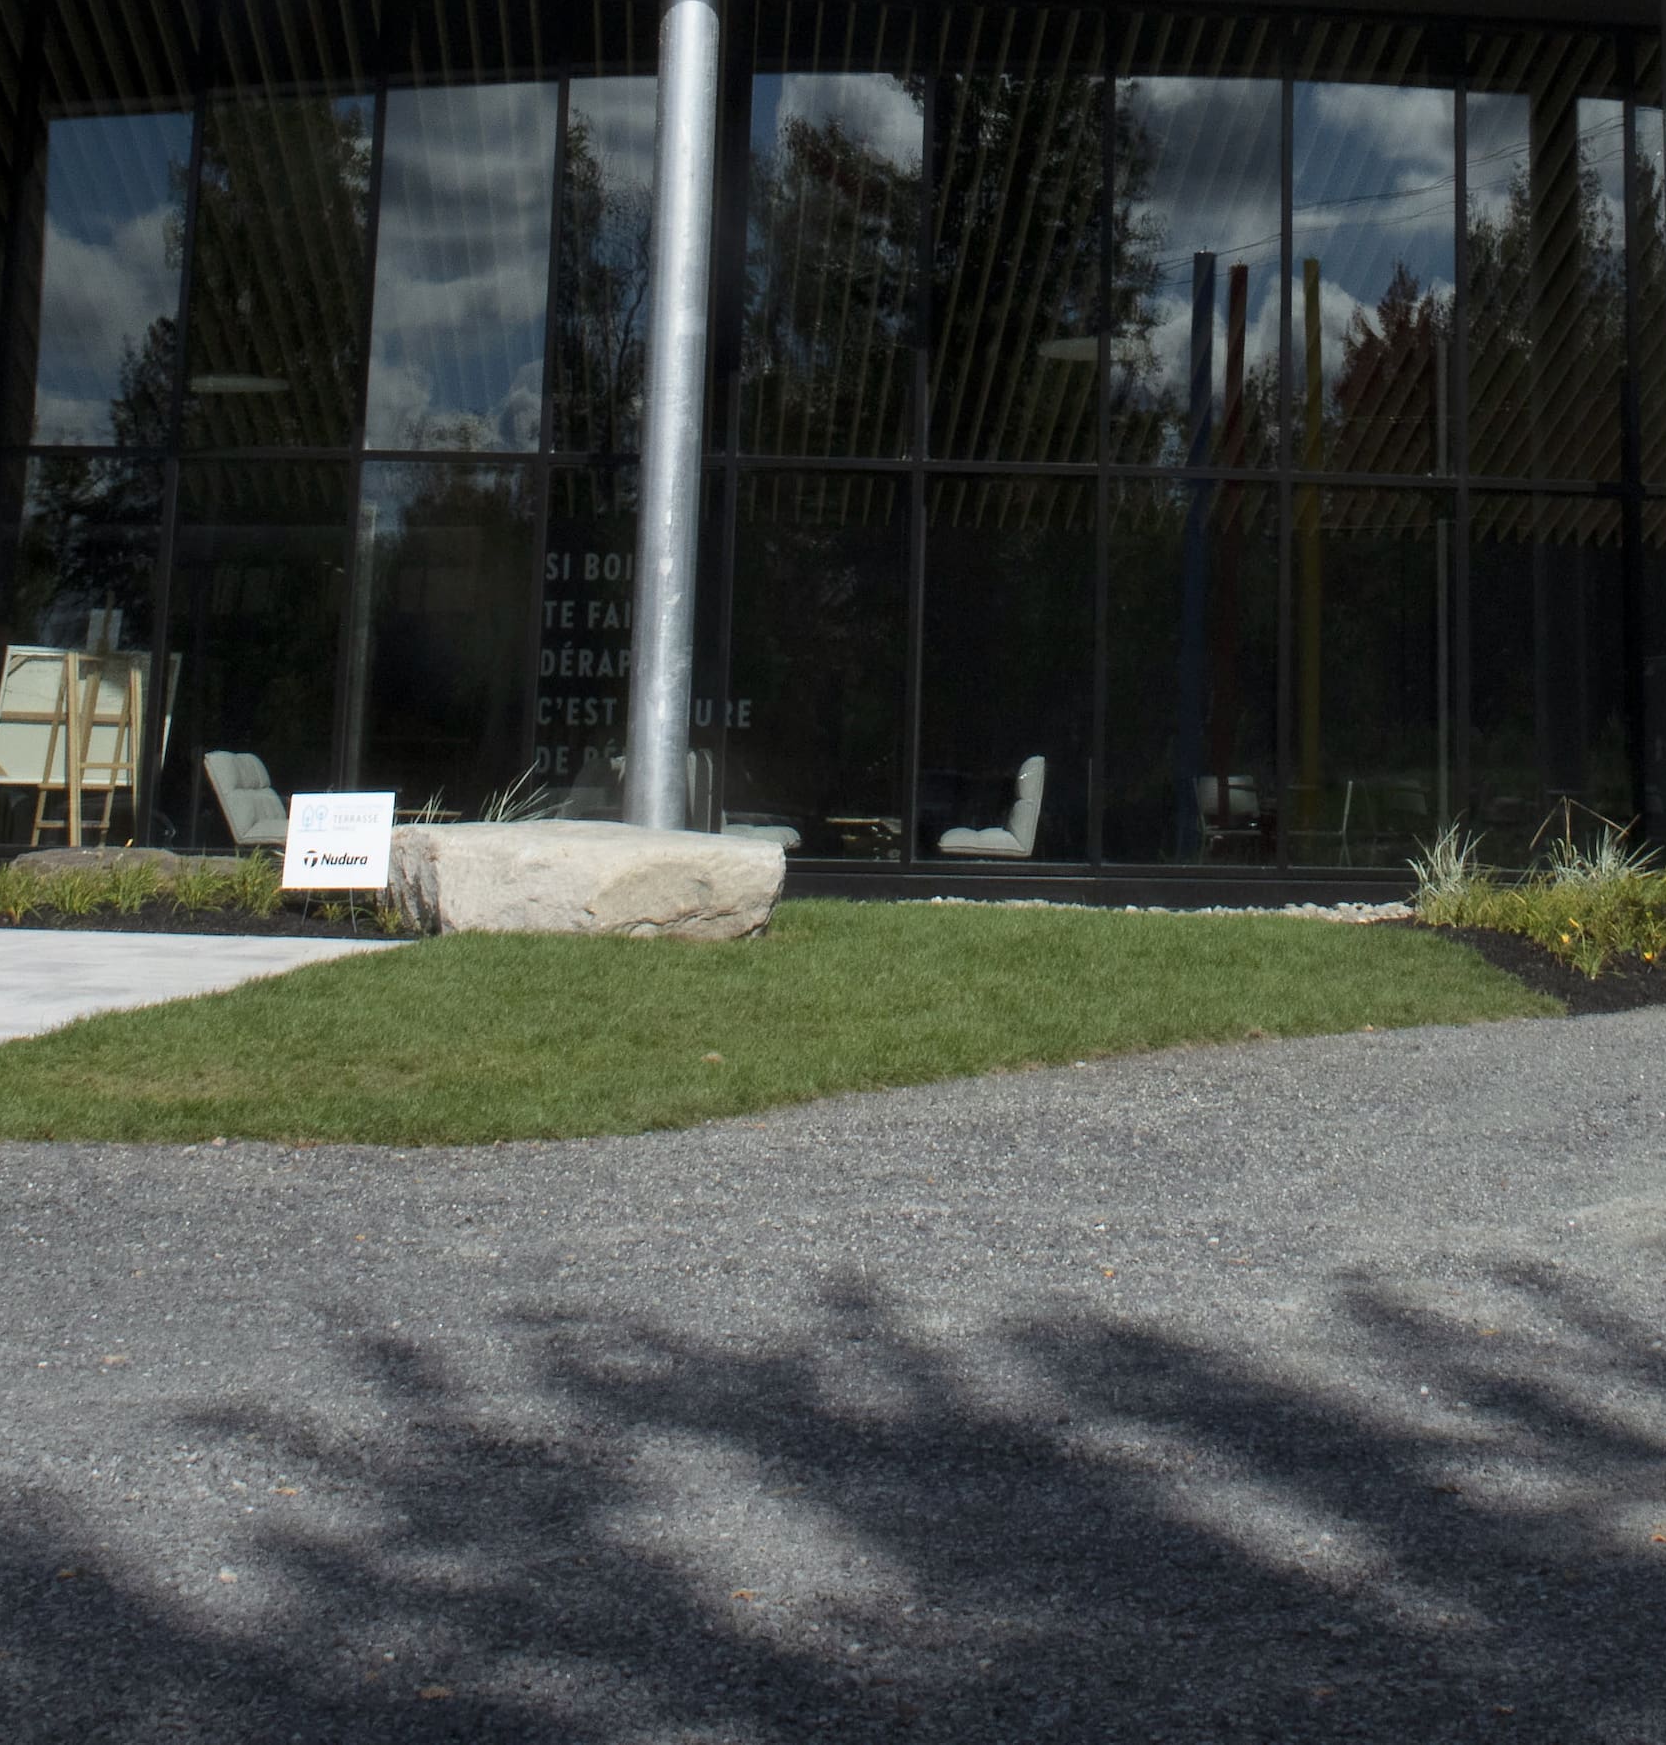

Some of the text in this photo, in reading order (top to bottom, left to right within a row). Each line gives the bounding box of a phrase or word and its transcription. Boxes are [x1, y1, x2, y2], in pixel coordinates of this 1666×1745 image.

[545, 552, 633, 581] SI BOI
[544, 600, 632, 629] TE FAI
[540, 641, 632, 677] DÉRAP
[537, 696, 618, 726] C'EST
[536, 745, 571, 775] DE
[320, 851, 369, 866] Nudura
